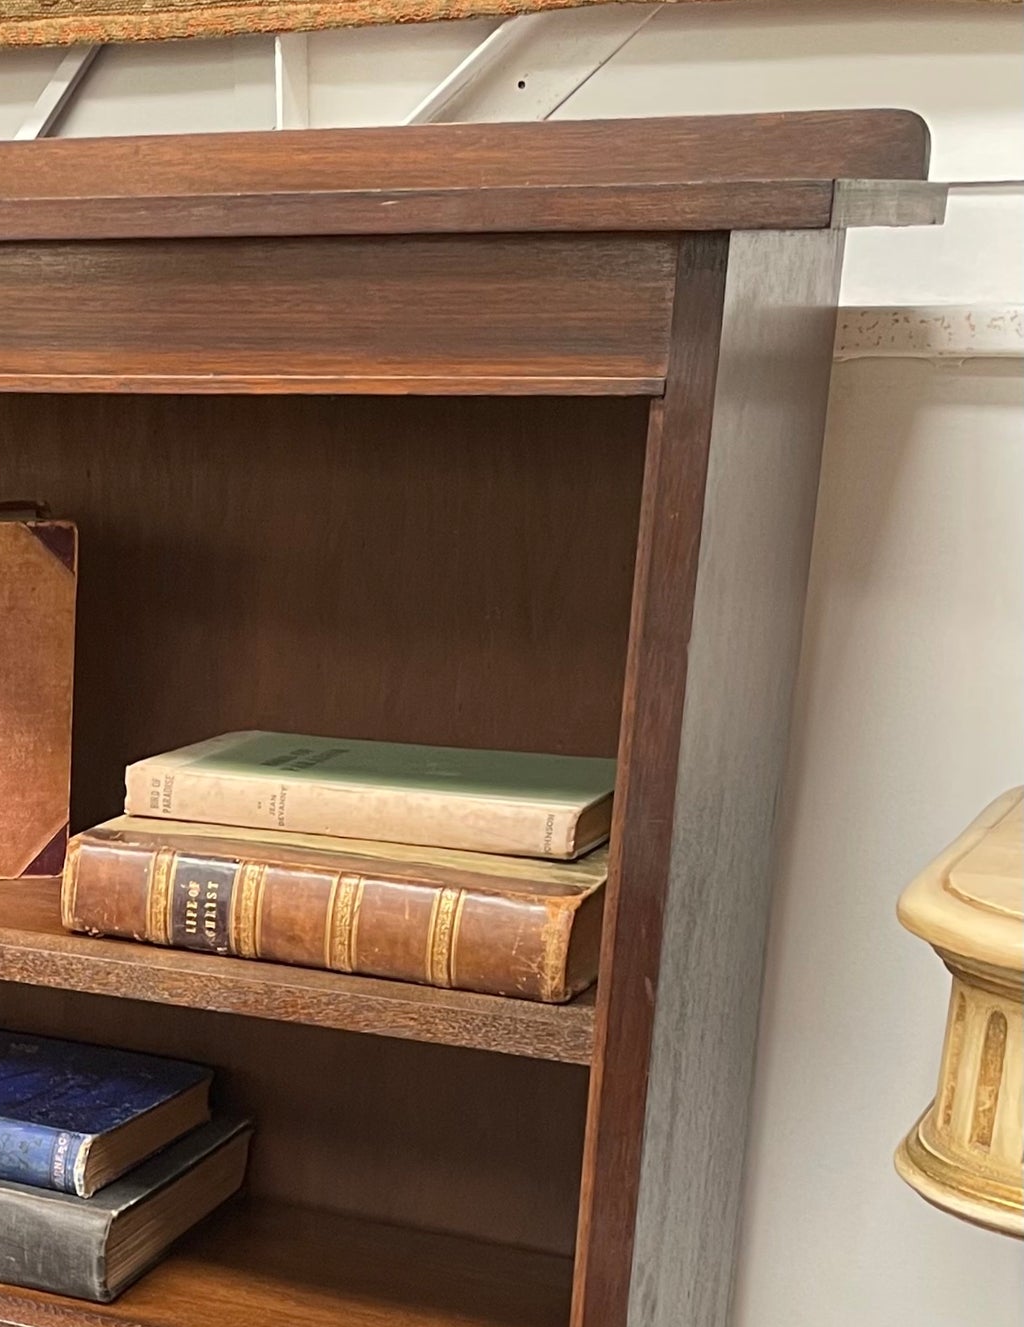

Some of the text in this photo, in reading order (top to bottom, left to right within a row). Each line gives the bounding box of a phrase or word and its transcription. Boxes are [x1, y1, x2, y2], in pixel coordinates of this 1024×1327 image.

[163, 775, 175, 814] PARADISE
[269, 794, 277, 816] JEAN
[185, 880, 200, 934] LIFE OF
[204, 881, 219, 938] CHRIST
